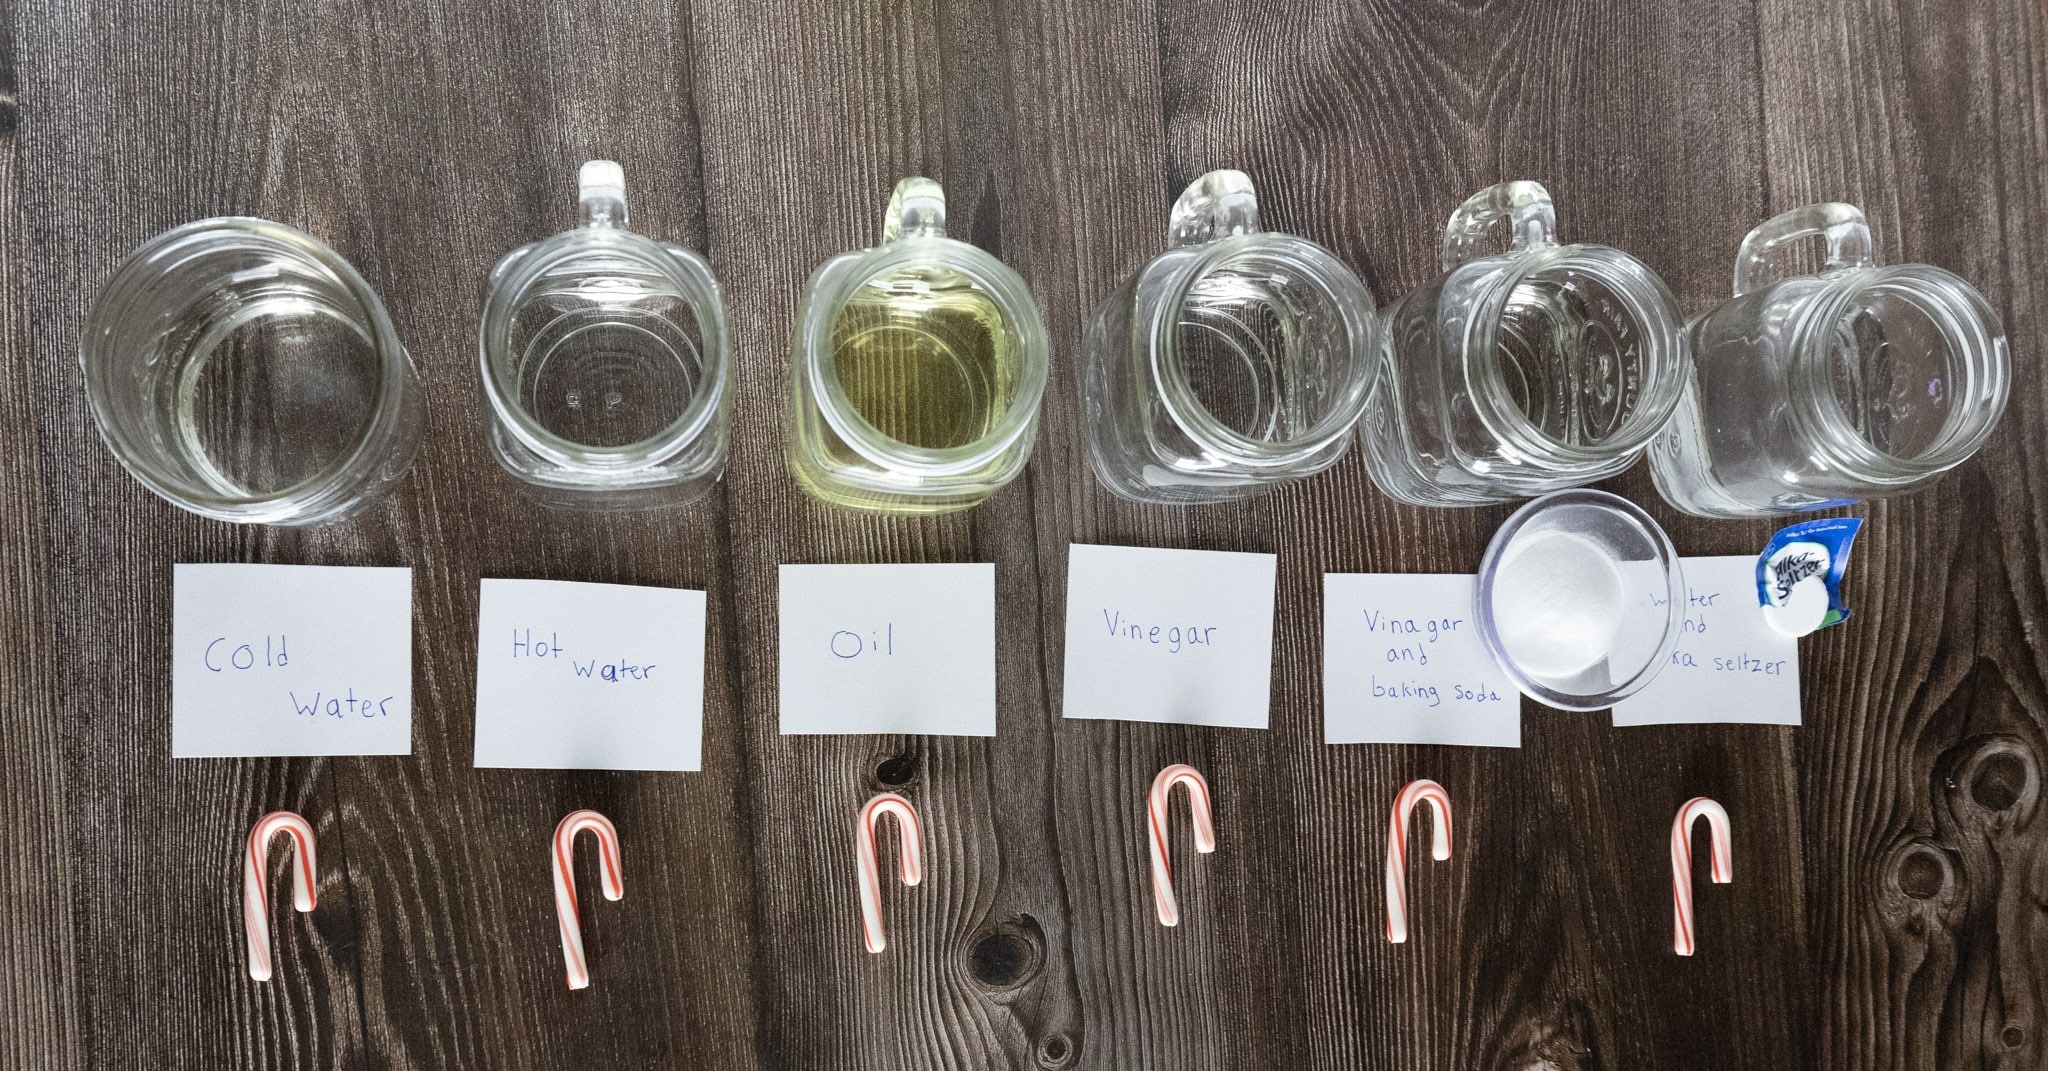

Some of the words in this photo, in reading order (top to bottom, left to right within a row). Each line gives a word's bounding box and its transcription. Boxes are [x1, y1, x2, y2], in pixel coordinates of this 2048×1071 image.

[1775, 551, 1816, 582] Alka-
[1650, 587, 1720, 607] wter
[1103, 607, 1218, 654] Vinegar
[1681, 613, 1707, 634] nd
[204, 635, 290, 673] Cold
[513, 628, 564, 659] Hot
[830, 622, 894, 660] Oil
[1387, 643, 1429, 667] and
[1671, 650, 1698, 668] ka
[1713, 652, 1787, 676] seltzer
[1371, 675, 1441, 707] baking
[1454, 681, 1502, 703] soda
